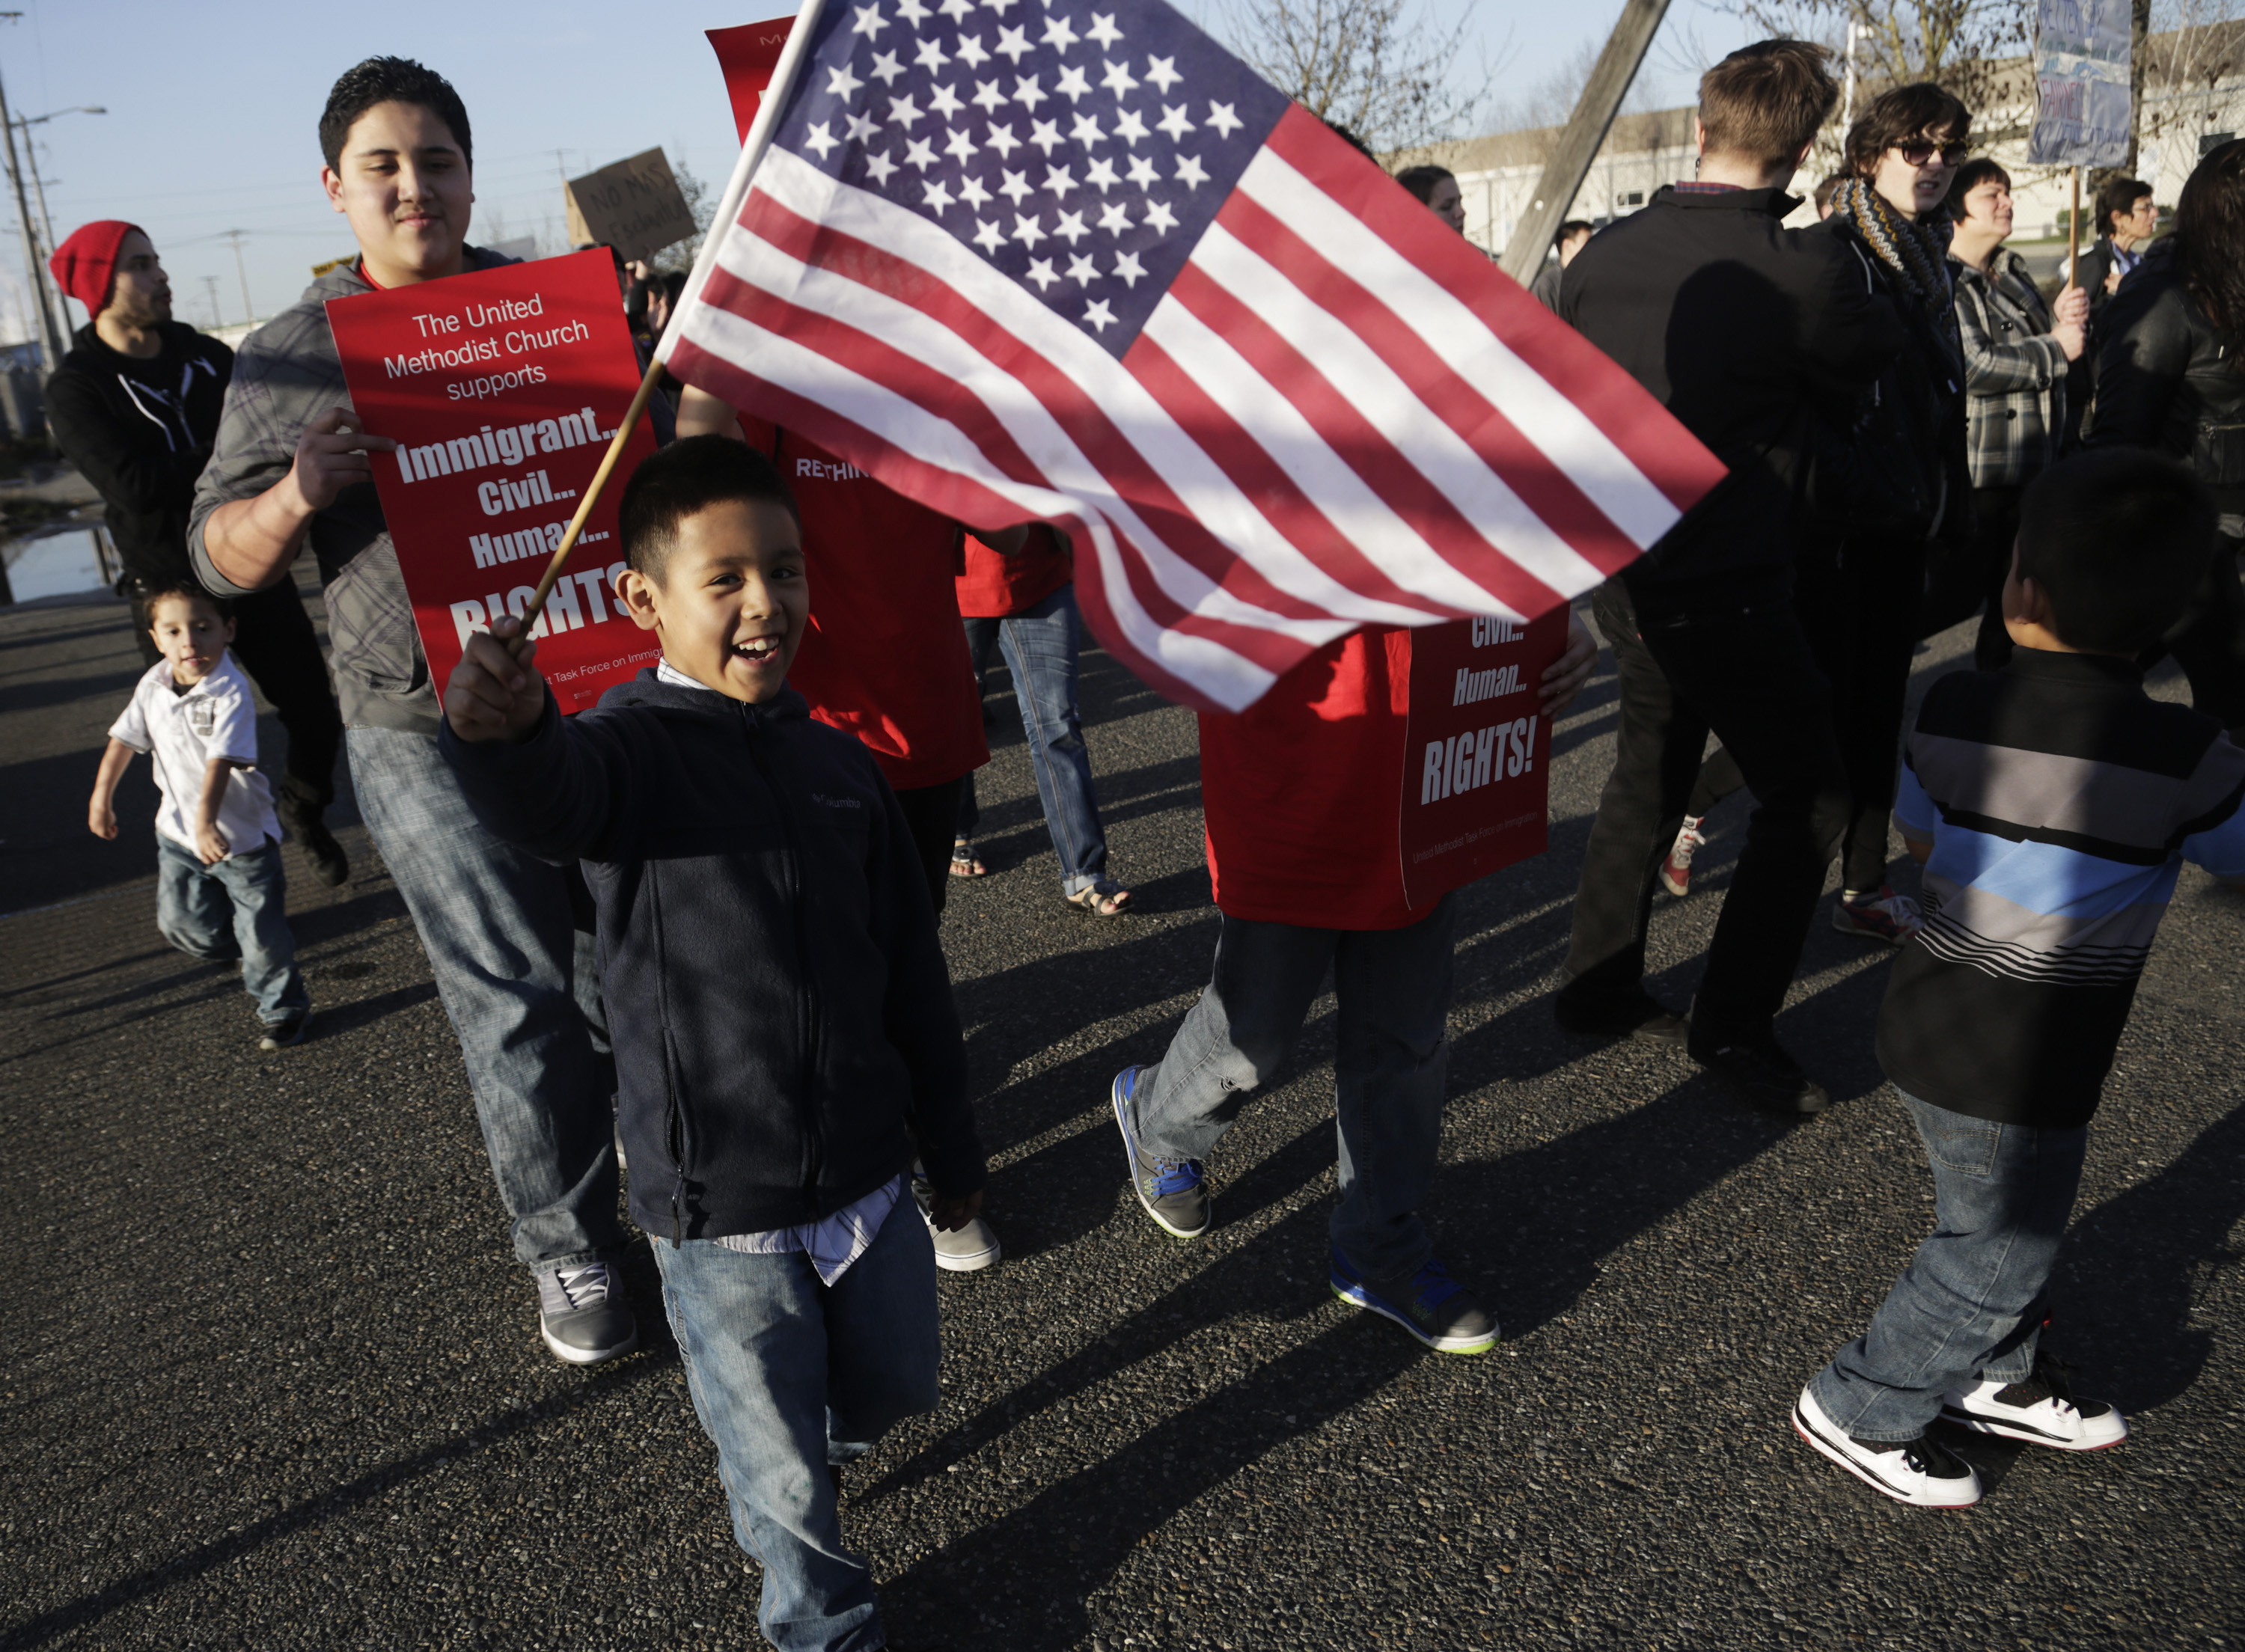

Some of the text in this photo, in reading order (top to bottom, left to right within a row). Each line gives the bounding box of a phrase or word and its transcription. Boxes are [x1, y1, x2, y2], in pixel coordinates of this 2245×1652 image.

[589, 184, 622, 213] NO
[623, 162, 671, 200] MAS
[412, 293, 544, 338] The United
[383, 319, 590, 379] Methodist Church
[446, 362, 548, 402] supports
[477, 469, 576, 516] Civil...
[553, 669, 578, 682] Task
[580, 661, 611, 676] Force
[612, 657, 626, 667] on
[1453, 663, 1527, 706] Human...
[1420, 715, 1539, 806] RIGHTS!
[1413, 811, 1539, 864] United Methodist Task Force on Immigration
